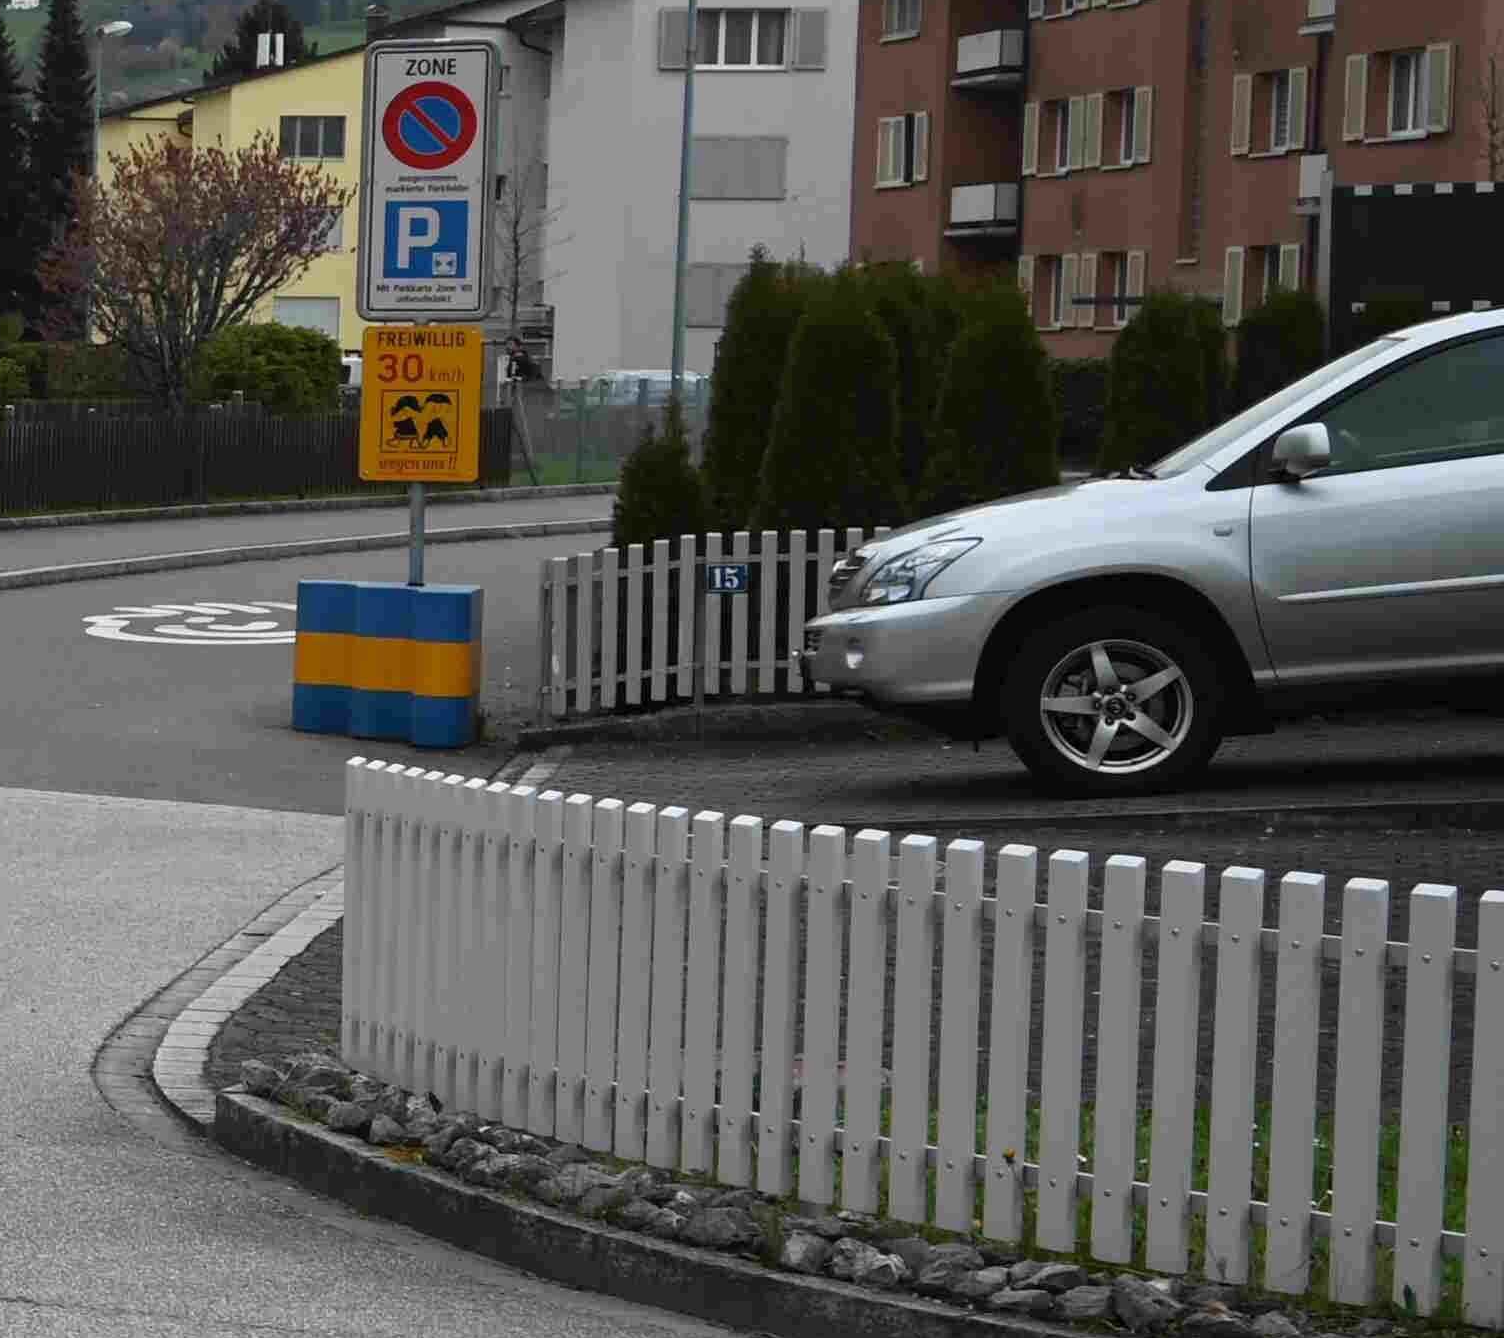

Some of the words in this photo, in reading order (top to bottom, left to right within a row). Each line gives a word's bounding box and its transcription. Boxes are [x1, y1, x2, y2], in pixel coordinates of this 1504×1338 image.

[405, 58, 457, 76] ZONE
[398, 207, 440, 269] P
[376, 331, 465, 348] FREIWILLIG
[377, 353, 424, 383] 30
[429, 366, 465, 382] km/h
[714, 568, 739, 588] 15
